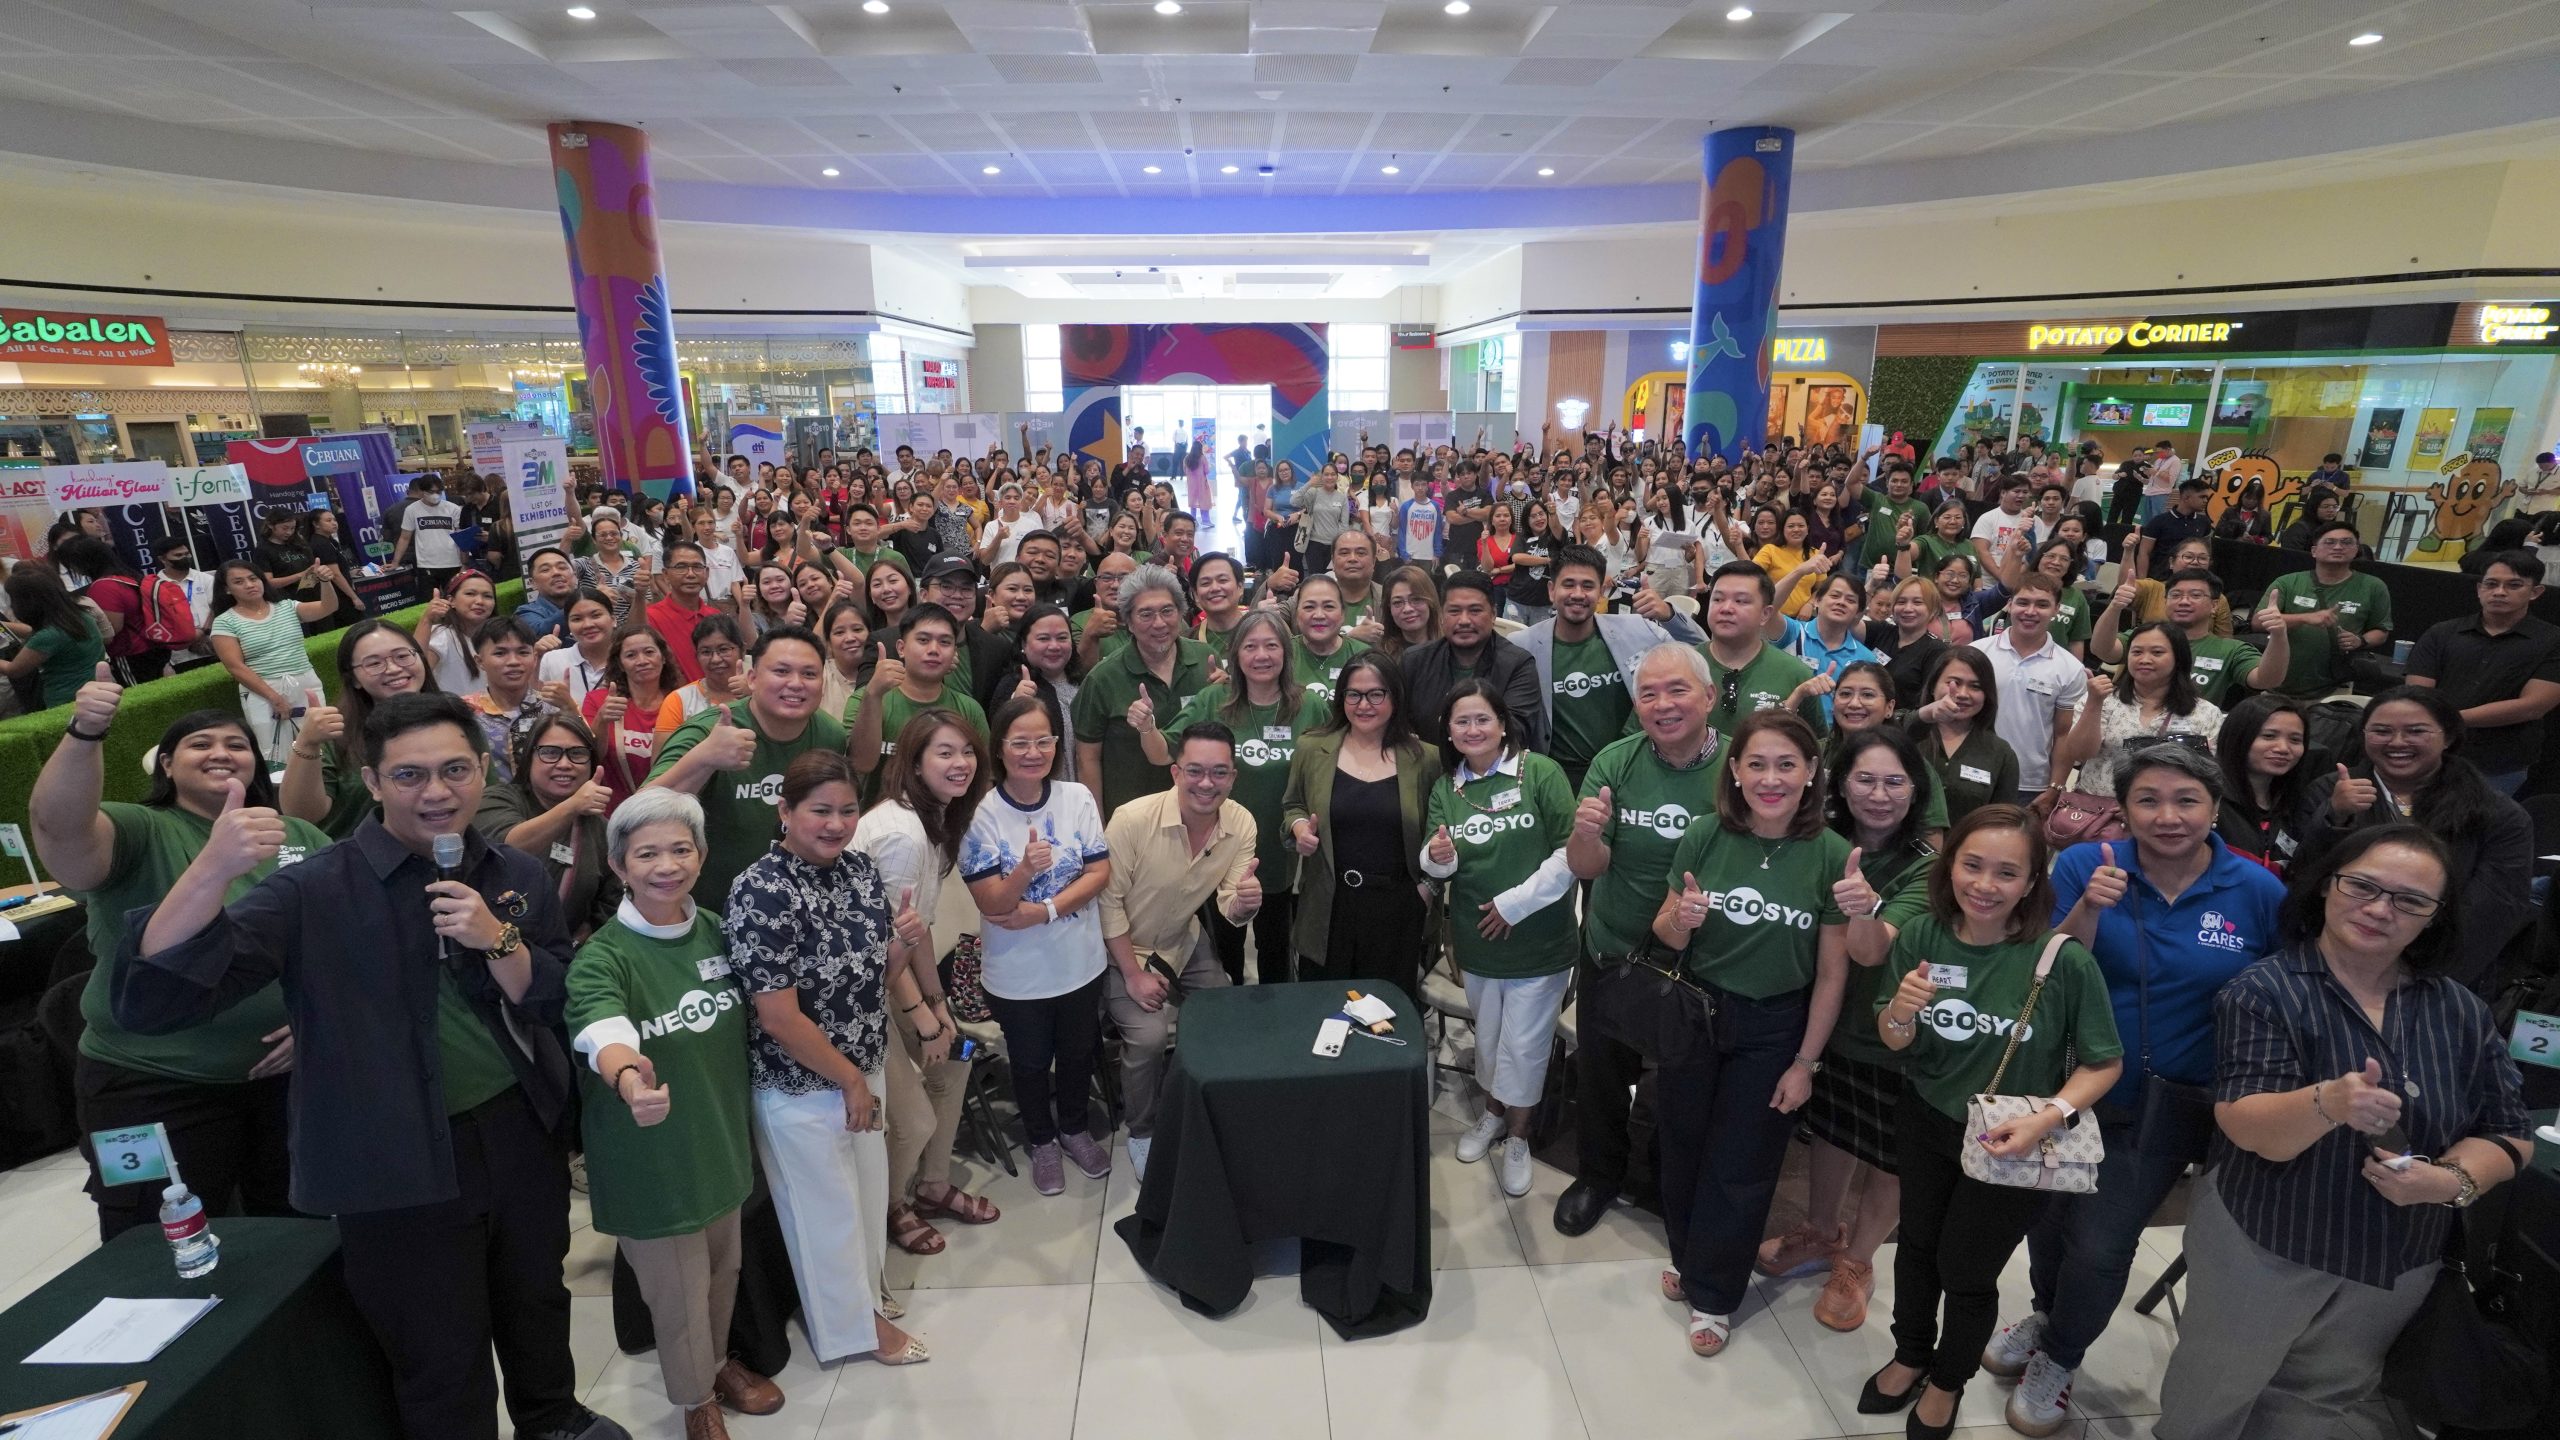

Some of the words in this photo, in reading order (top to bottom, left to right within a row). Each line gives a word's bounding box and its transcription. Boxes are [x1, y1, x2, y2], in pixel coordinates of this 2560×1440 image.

[2029, 324, 2123, 350] POTATO
[2127, 322, 2231, 346] CORNER
[6, 344, 23, 353] All
[72, 347, 94, 356] Eat
[129, 347, 156, 357] Want
[1773, 338, 1826, 362] PIZZA
[1988, 369, 2015, 377] POTATO
[2016, 370, 2043, 379] CRNER
[752, 440, 765, 452] dti
[305, 446, 360, 466] CEBUANA
[2208, 450, 2237, 469] POCO!
[2441, 454, 2468, 475] POCO!
[61, 483, 118, 500] Million
[116, 480, 161, 498] Glow
[520, 506, 567, 522] EXHIBITORS
[532, 501, 543, 509] LIST
[1552, 672, 1623, 694] EGOSYO
[1750, 692, 1780, 700] NEGOSYO
[624, 736, 652, 747] Lev
[1235, 745, 1295, 760] EGOSY
[736, 781, 784, 799] NEGO
[1620, 808, 1700, 831] NEGO
[1702, 890, 1813, 930] EGOSYO
[2197, 930, 2244, 949] CARES
[641, 987, 743, 1040] NEGOSY
[1919, 1005, 2033, 1042] EGOSYO
[2530, 1036, 2549, 1054] 2
[105, 1132, 148, 1144] NEGOSYO
[121, 1152, 141, 1170] 3
